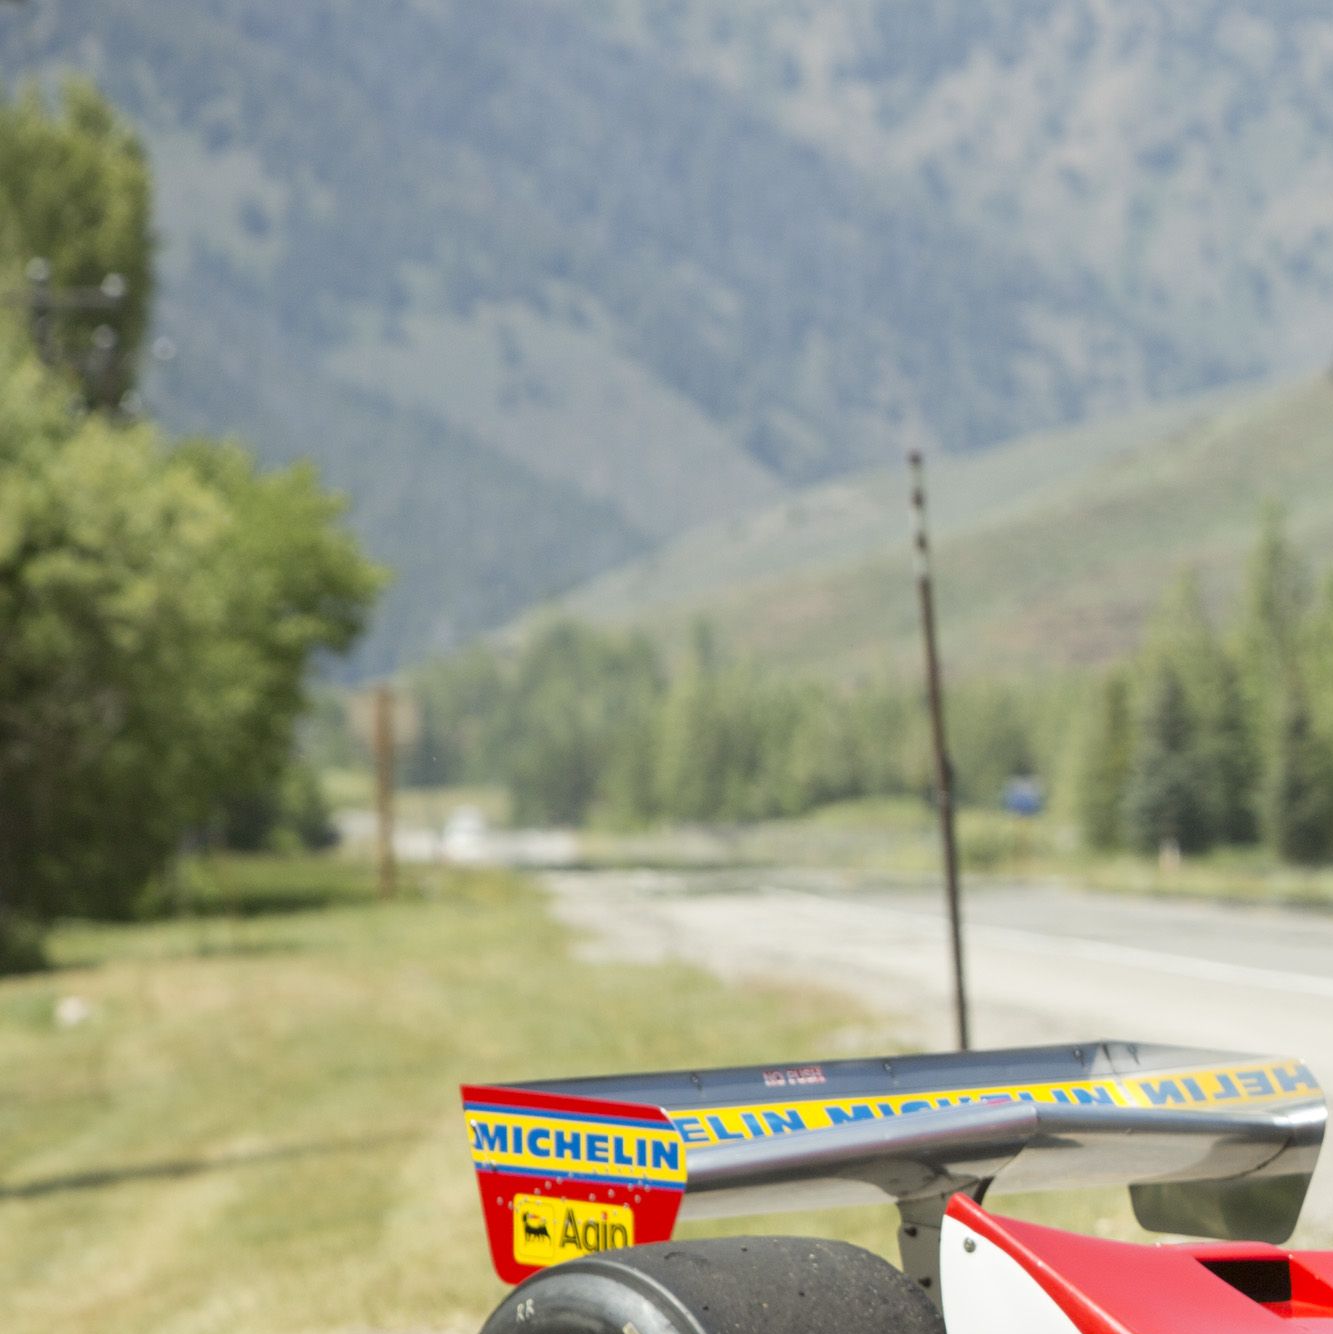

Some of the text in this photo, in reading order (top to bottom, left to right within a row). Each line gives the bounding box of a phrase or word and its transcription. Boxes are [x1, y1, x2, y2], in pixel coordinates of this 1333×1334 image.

[673, 1086, 1115, 1142] ELIN MICIN
[475, 1122, 679, 1170] MICHELIN
